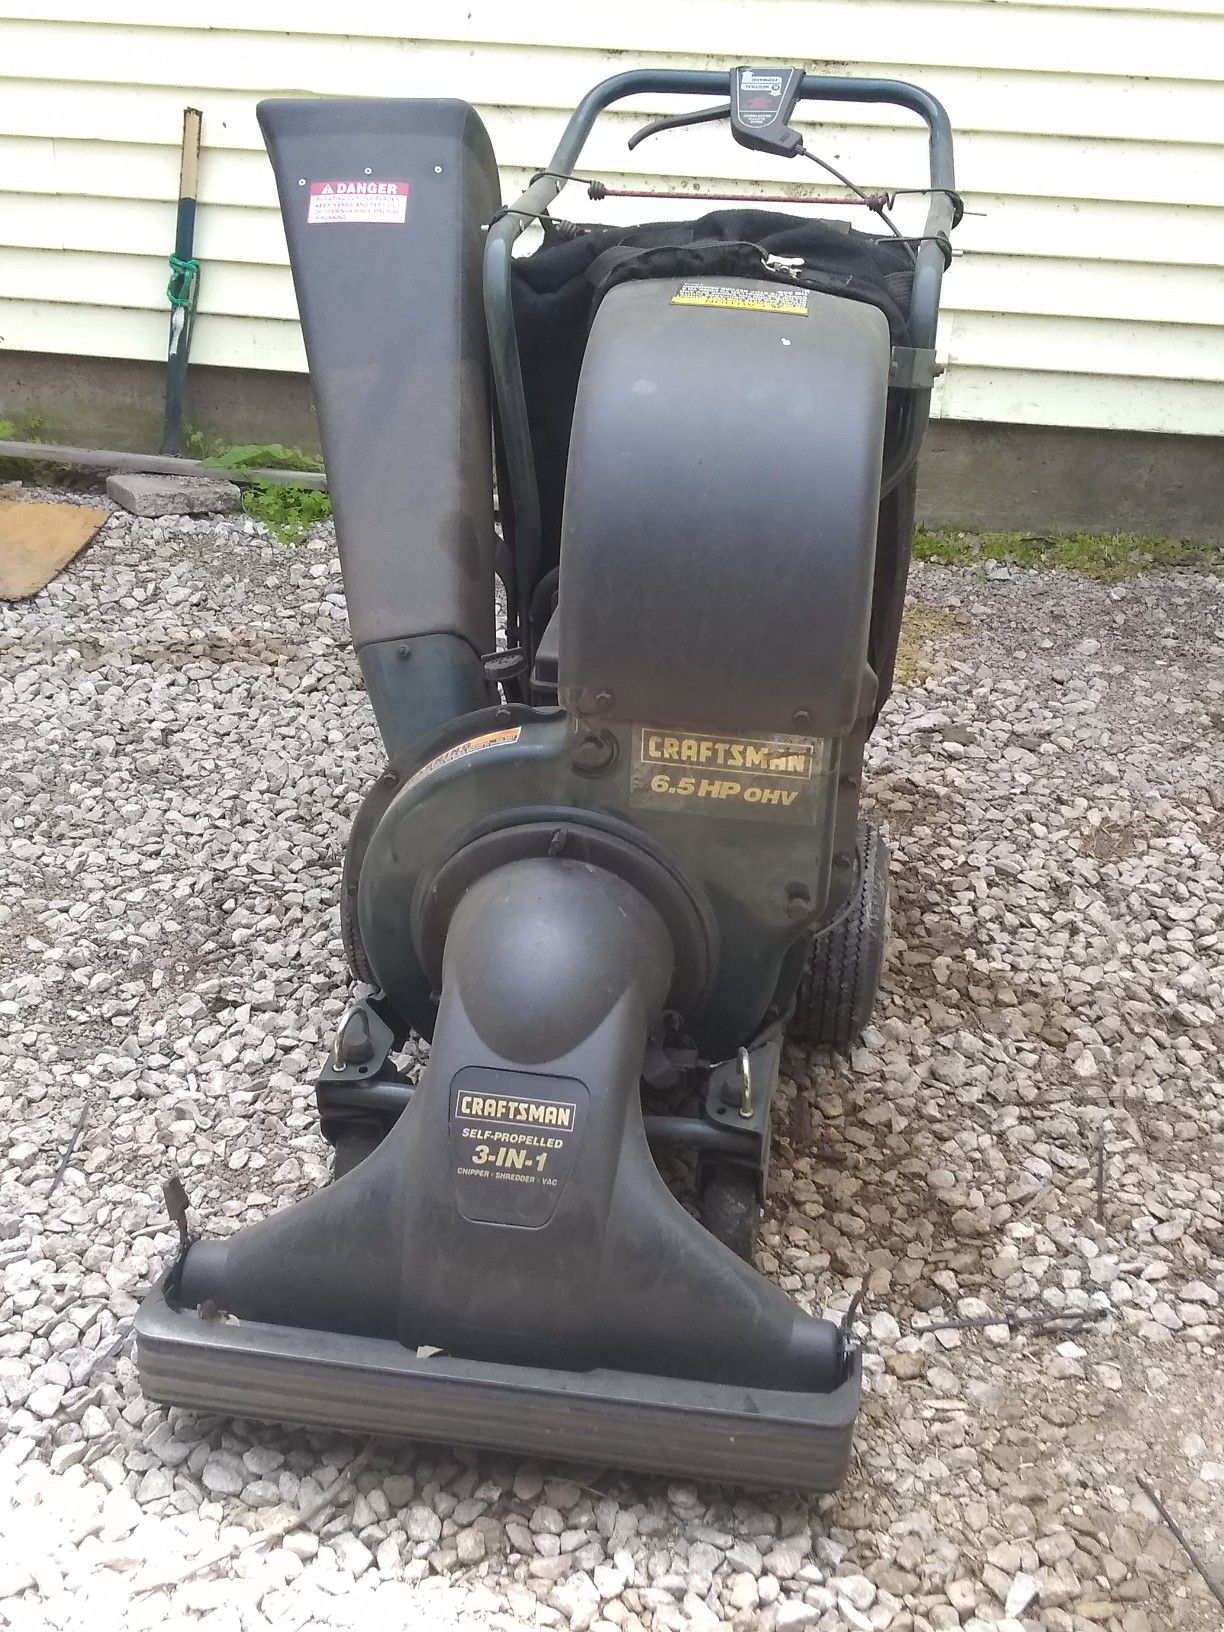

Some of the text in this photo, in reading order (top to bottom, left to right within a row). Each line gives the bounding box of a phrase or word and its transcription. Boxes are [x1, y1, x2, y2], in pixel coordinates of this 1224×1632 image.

[336, 182, 398, 194] DANGER
[648, 735, 806, 773] CRAFTSMAN
[651, 774, 799, 806] 6.5 HP OHV
[461, 1096, 571, 1126] CRAFTSMAN
[462, 1128, 564, 1149] SELF-PROPELLED
[472, 1144, 548, 1172] 3-IN-1
[457, 1167, 558, 1186] CHIPPER SHREDDER VAC
